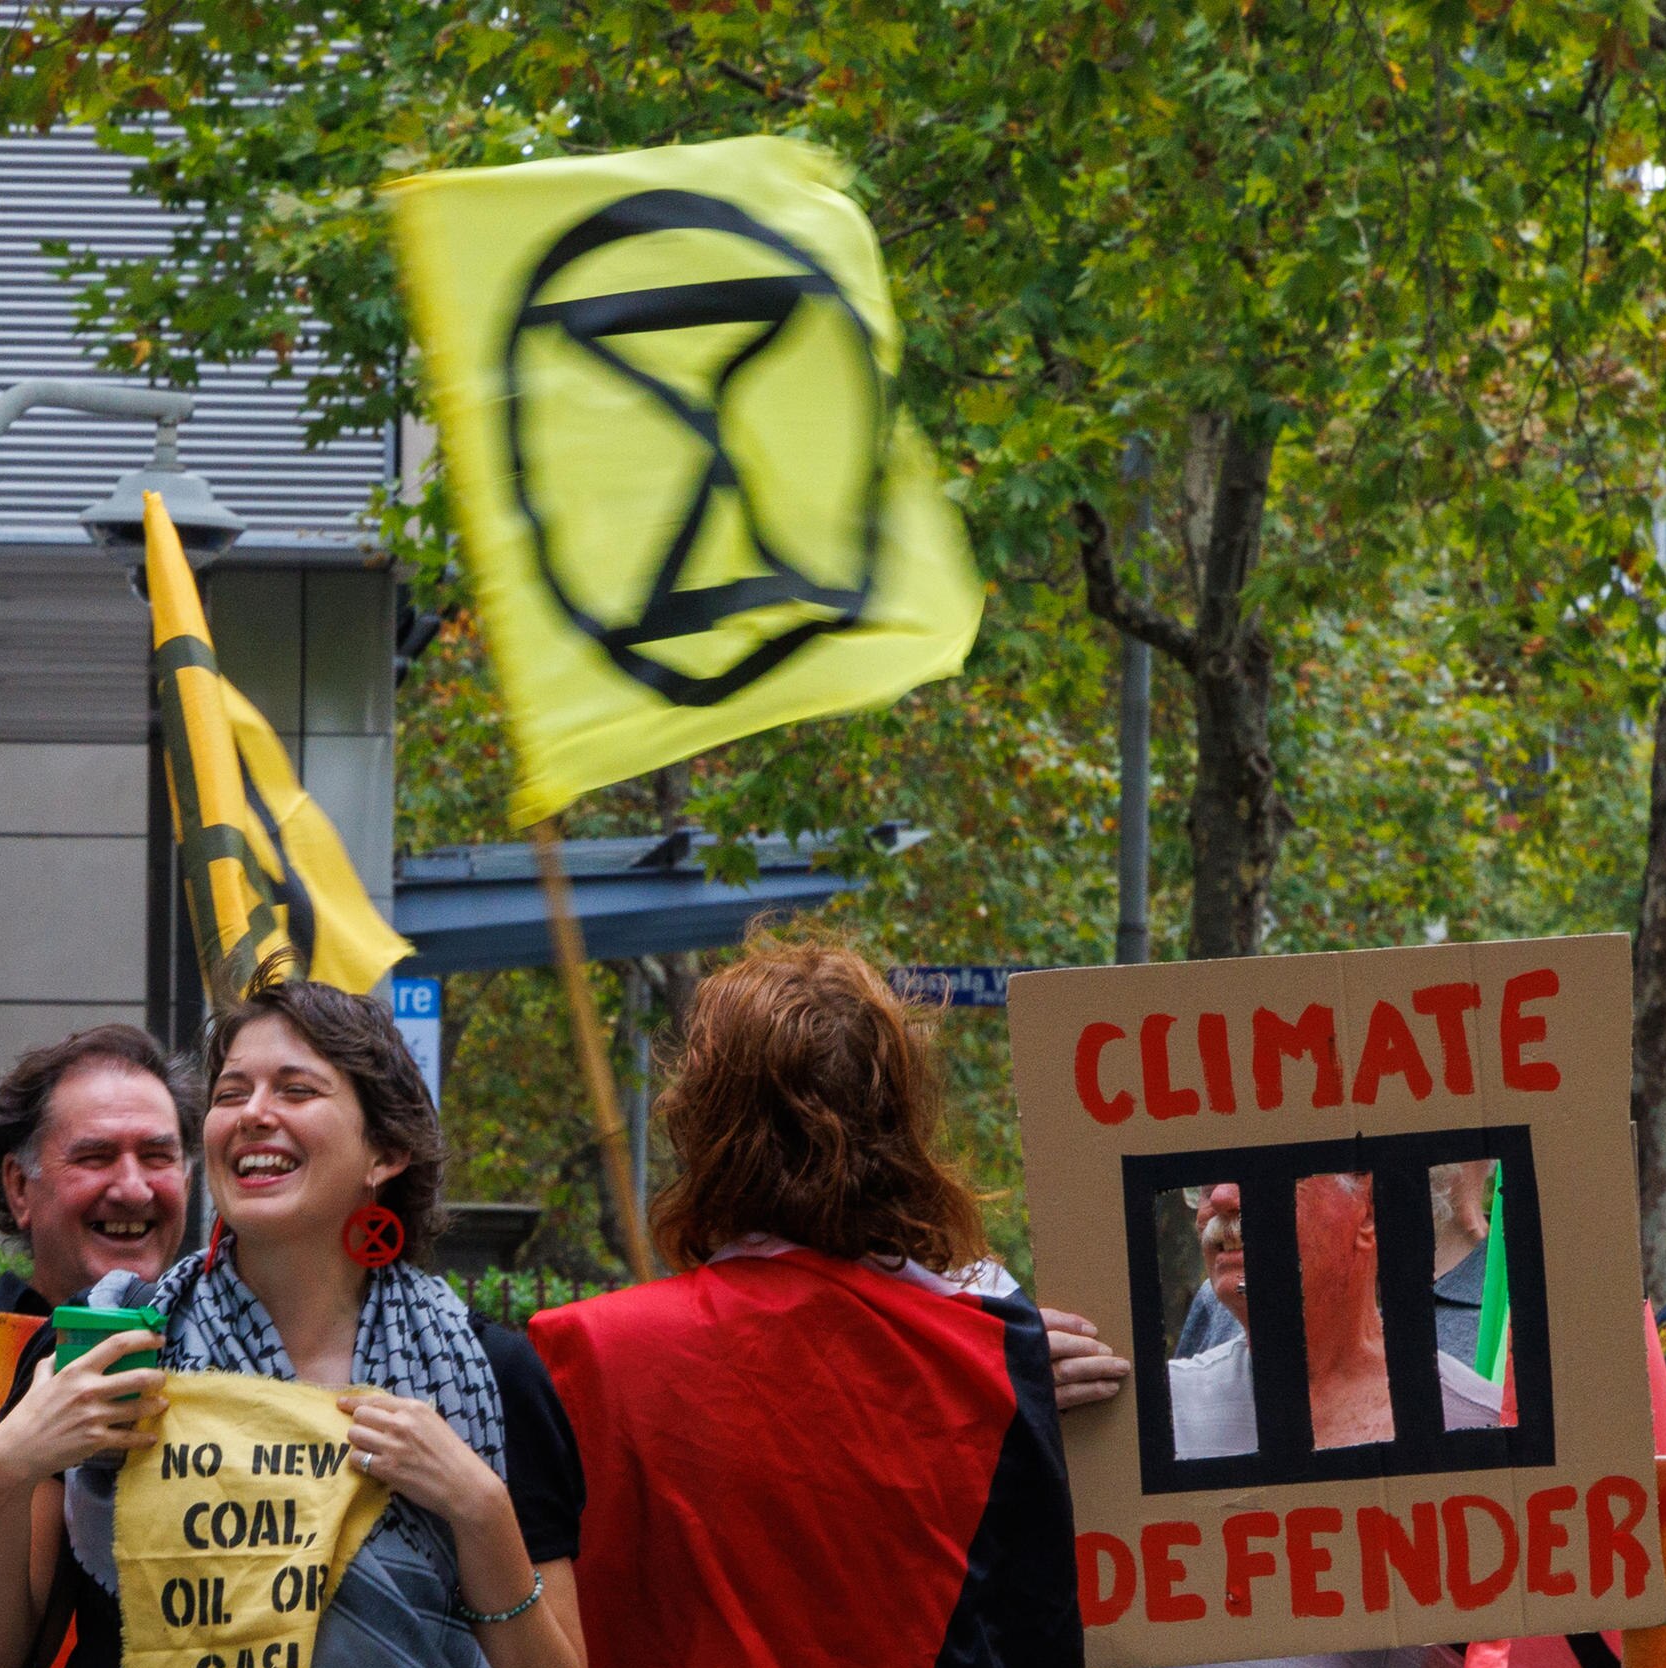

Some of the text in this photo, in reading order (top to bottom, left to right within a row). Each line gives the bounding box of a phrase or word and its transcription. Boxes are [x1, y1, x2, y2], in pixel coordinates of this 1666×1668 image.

[399, 986, 432, 1013] re
[1074, 968, 1561, 1125] CLIMATE
[161, 1442, 349, 1480] NO NEW
[183, 1498, 317, 1549] COAL,
[1076, 1476, 1650, 1628] DEFENDER
